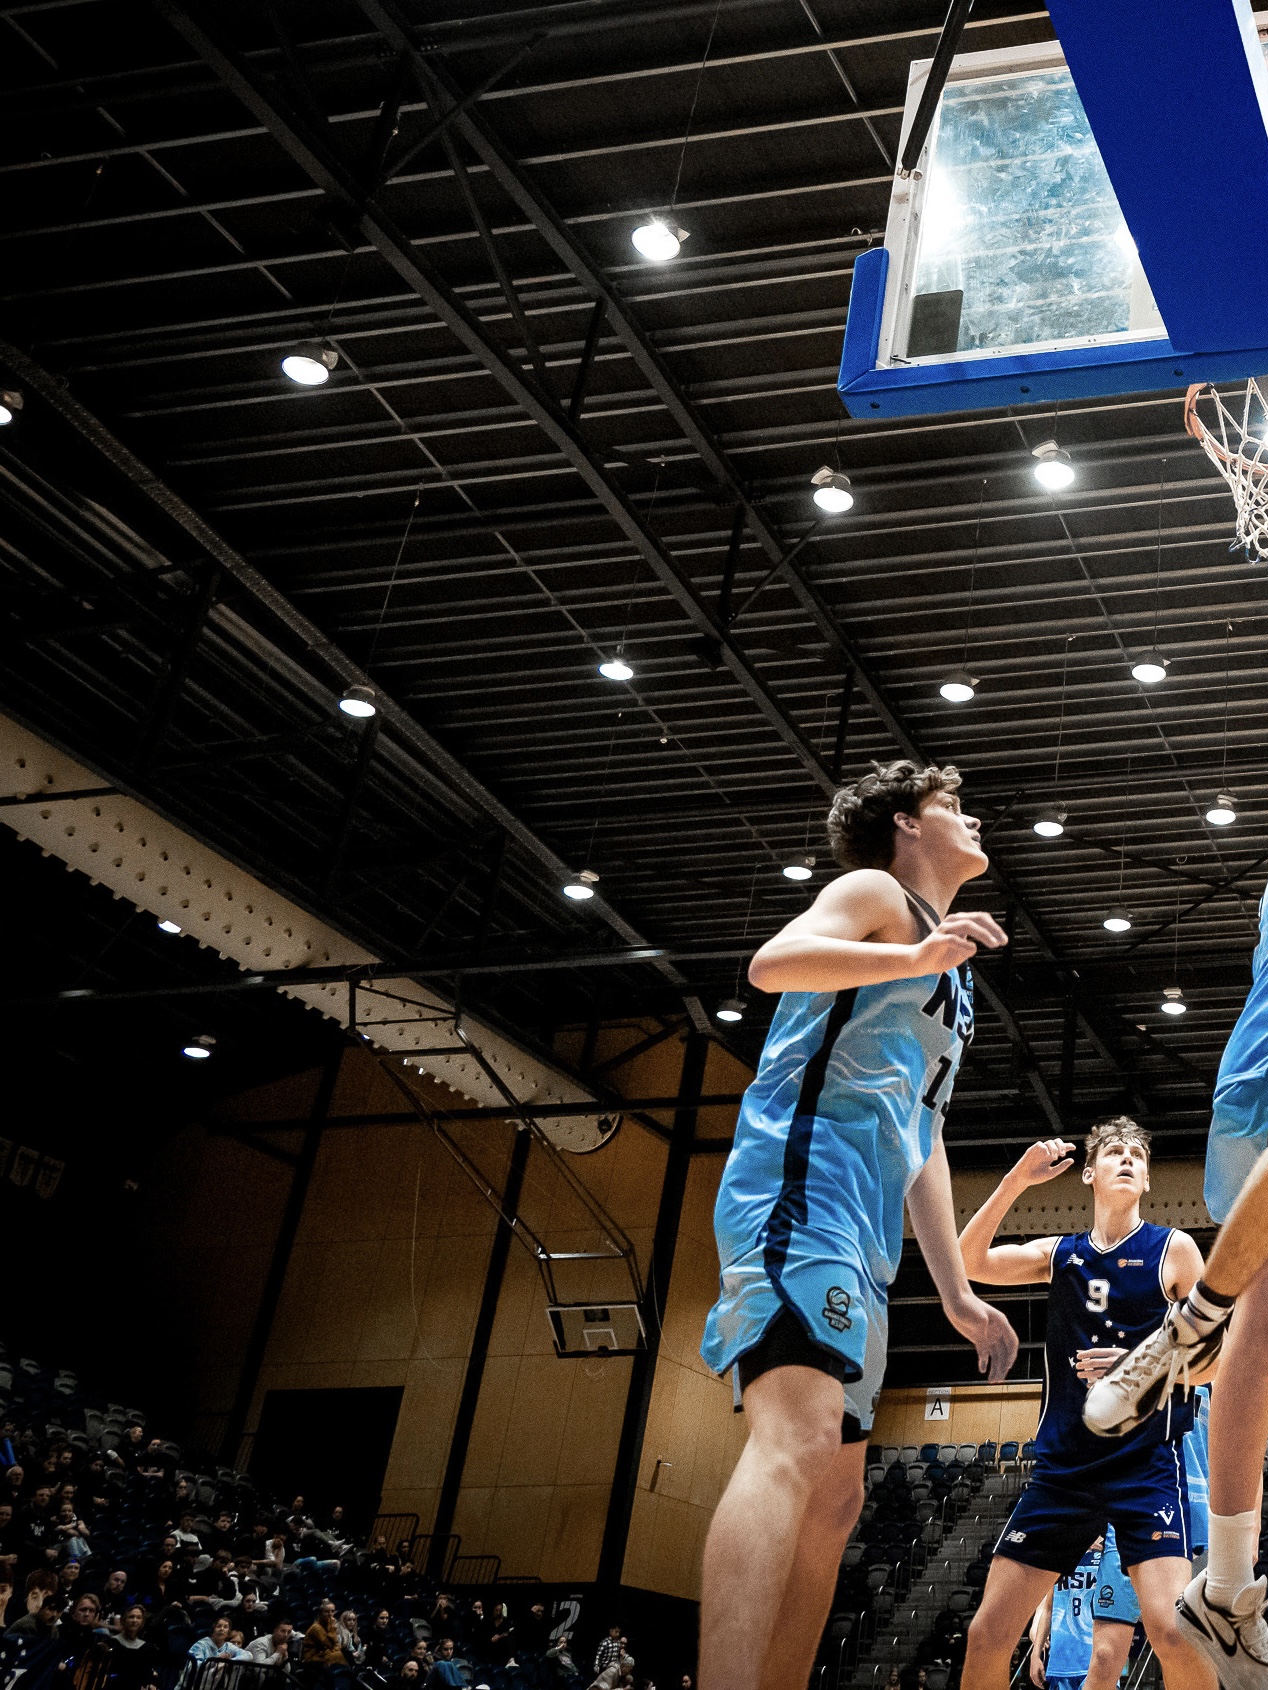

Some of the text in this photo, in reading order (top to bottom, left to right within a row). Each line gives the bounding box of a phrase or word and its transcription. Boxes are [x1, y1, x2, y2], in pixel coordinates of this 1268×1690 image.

[1086, 1278, 1110, 1313] 9
[930, 1397, 944, 1416] A
[549, 1600, 580, 1640] 2
[1072, 1597, 1082, 1617] 8
